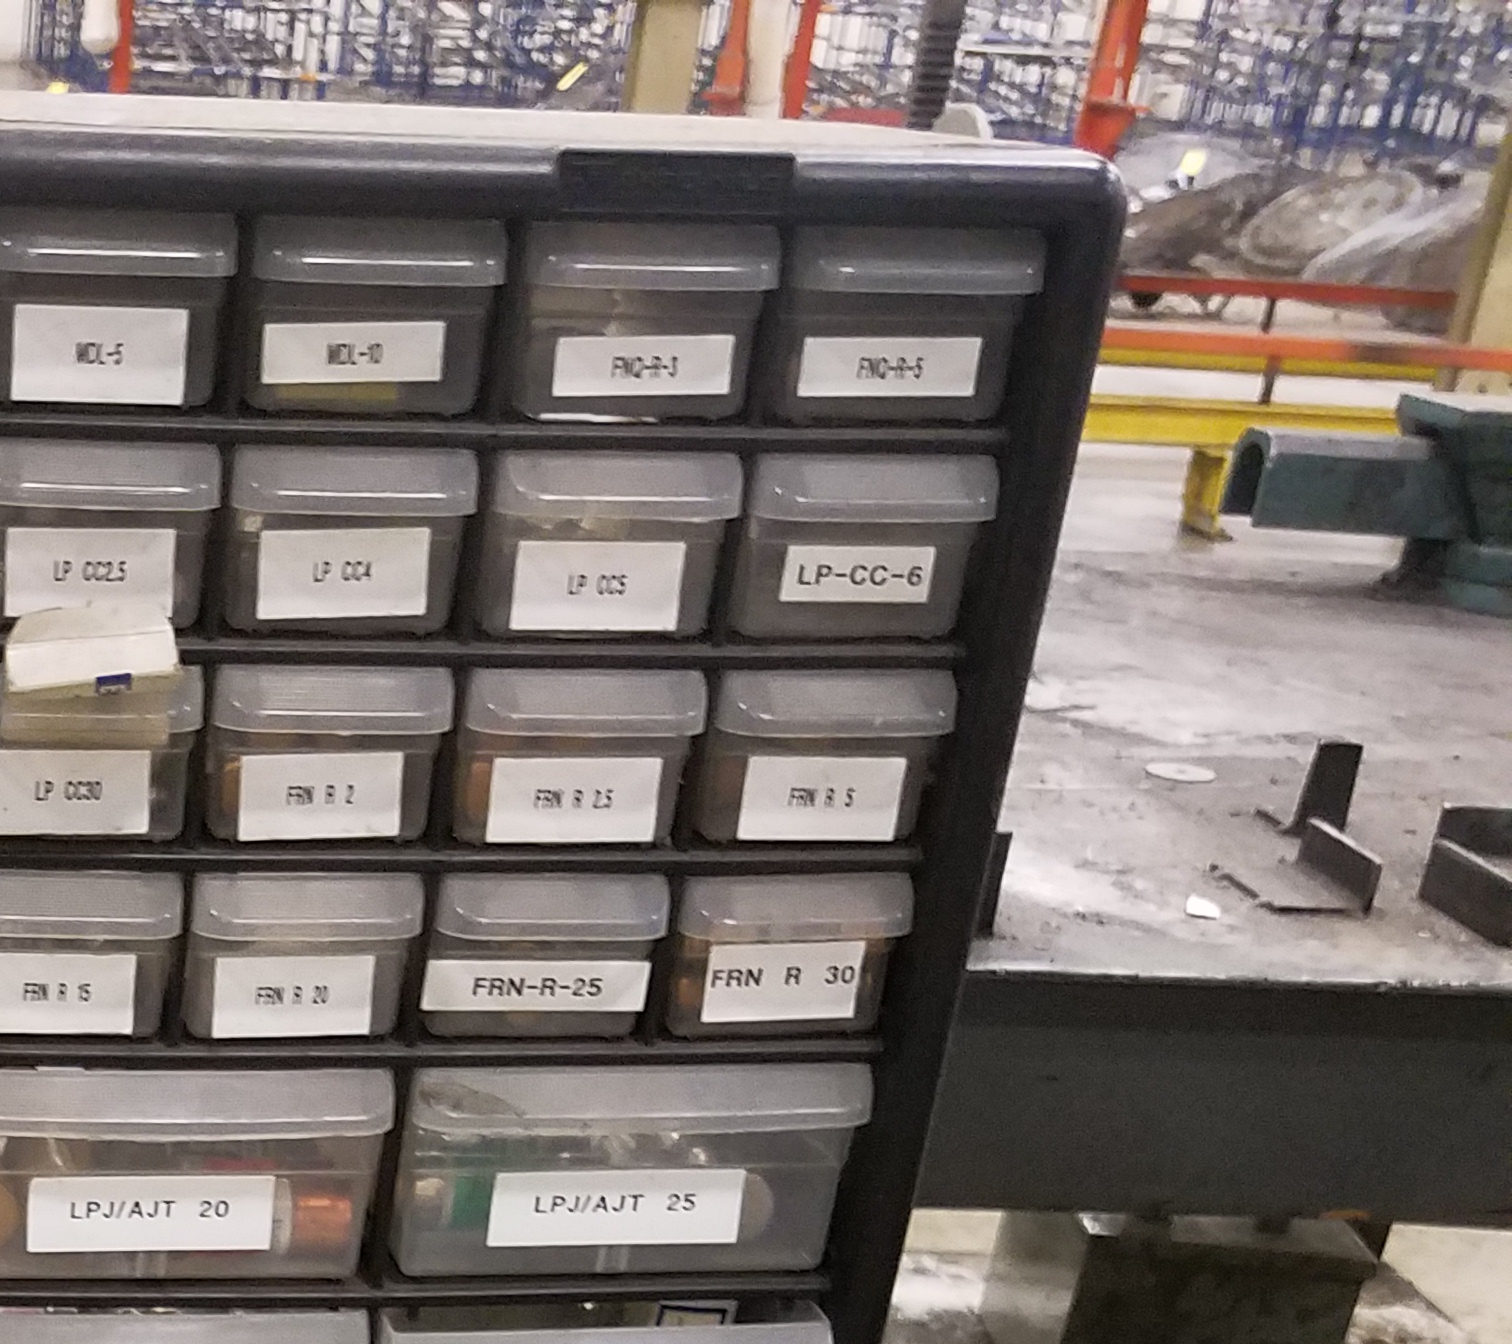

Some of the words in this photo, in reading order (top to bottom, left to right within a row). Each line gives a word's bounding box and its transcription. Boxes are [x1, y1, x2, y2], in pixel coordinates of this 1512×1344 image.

[76, 342, 124, 365] MDL-5
[327, 343, 383, 365] MDL-10
[54, 561, 72, 581] LP
[313, 561, 332, 582] LP
[342, 561, 371, 581] CC4
[797, 564, 923, 586] LP-CC-6
[568, 574, 587, 595] LP
[597, 574, 628, 595] CC5
[35, 781, 54, 801] LP
[64, 781, 102, 800] CC30
[287, 786, 314, 805] FRN
[326, 785, 335, 804] R
[345, 785, 354, 804] 2
[534, 789, 564, 808] FRN
[574, 790, 583, 807] R
[788, 788, 818, 806] FRN
[824, 788, 835, 806] R
[845, 788, 856, 807] 5
[472, 977, 603, 997] FRN-R-25
[711, 968, 763, 988] FRN
[785, 966, 801, 985] R
[824, 965, 857, 989] 30
[23, 983, 48, 1001] FRN
[58, 983, 67, 1000] R
[78, 983, 91, 1002] 15
[256, 987, 284, 1005] FRN
[293, 986, 302, 1003] R
[312, 986, 328, 1004] 20
[71, 1200, 176, 1219] LPJ/AJT
[199, 1200, 229, 1217] 20
[534, 1194, 645, 1213] LPJ/AJT
[667, 1193, 696, 1211] 25
